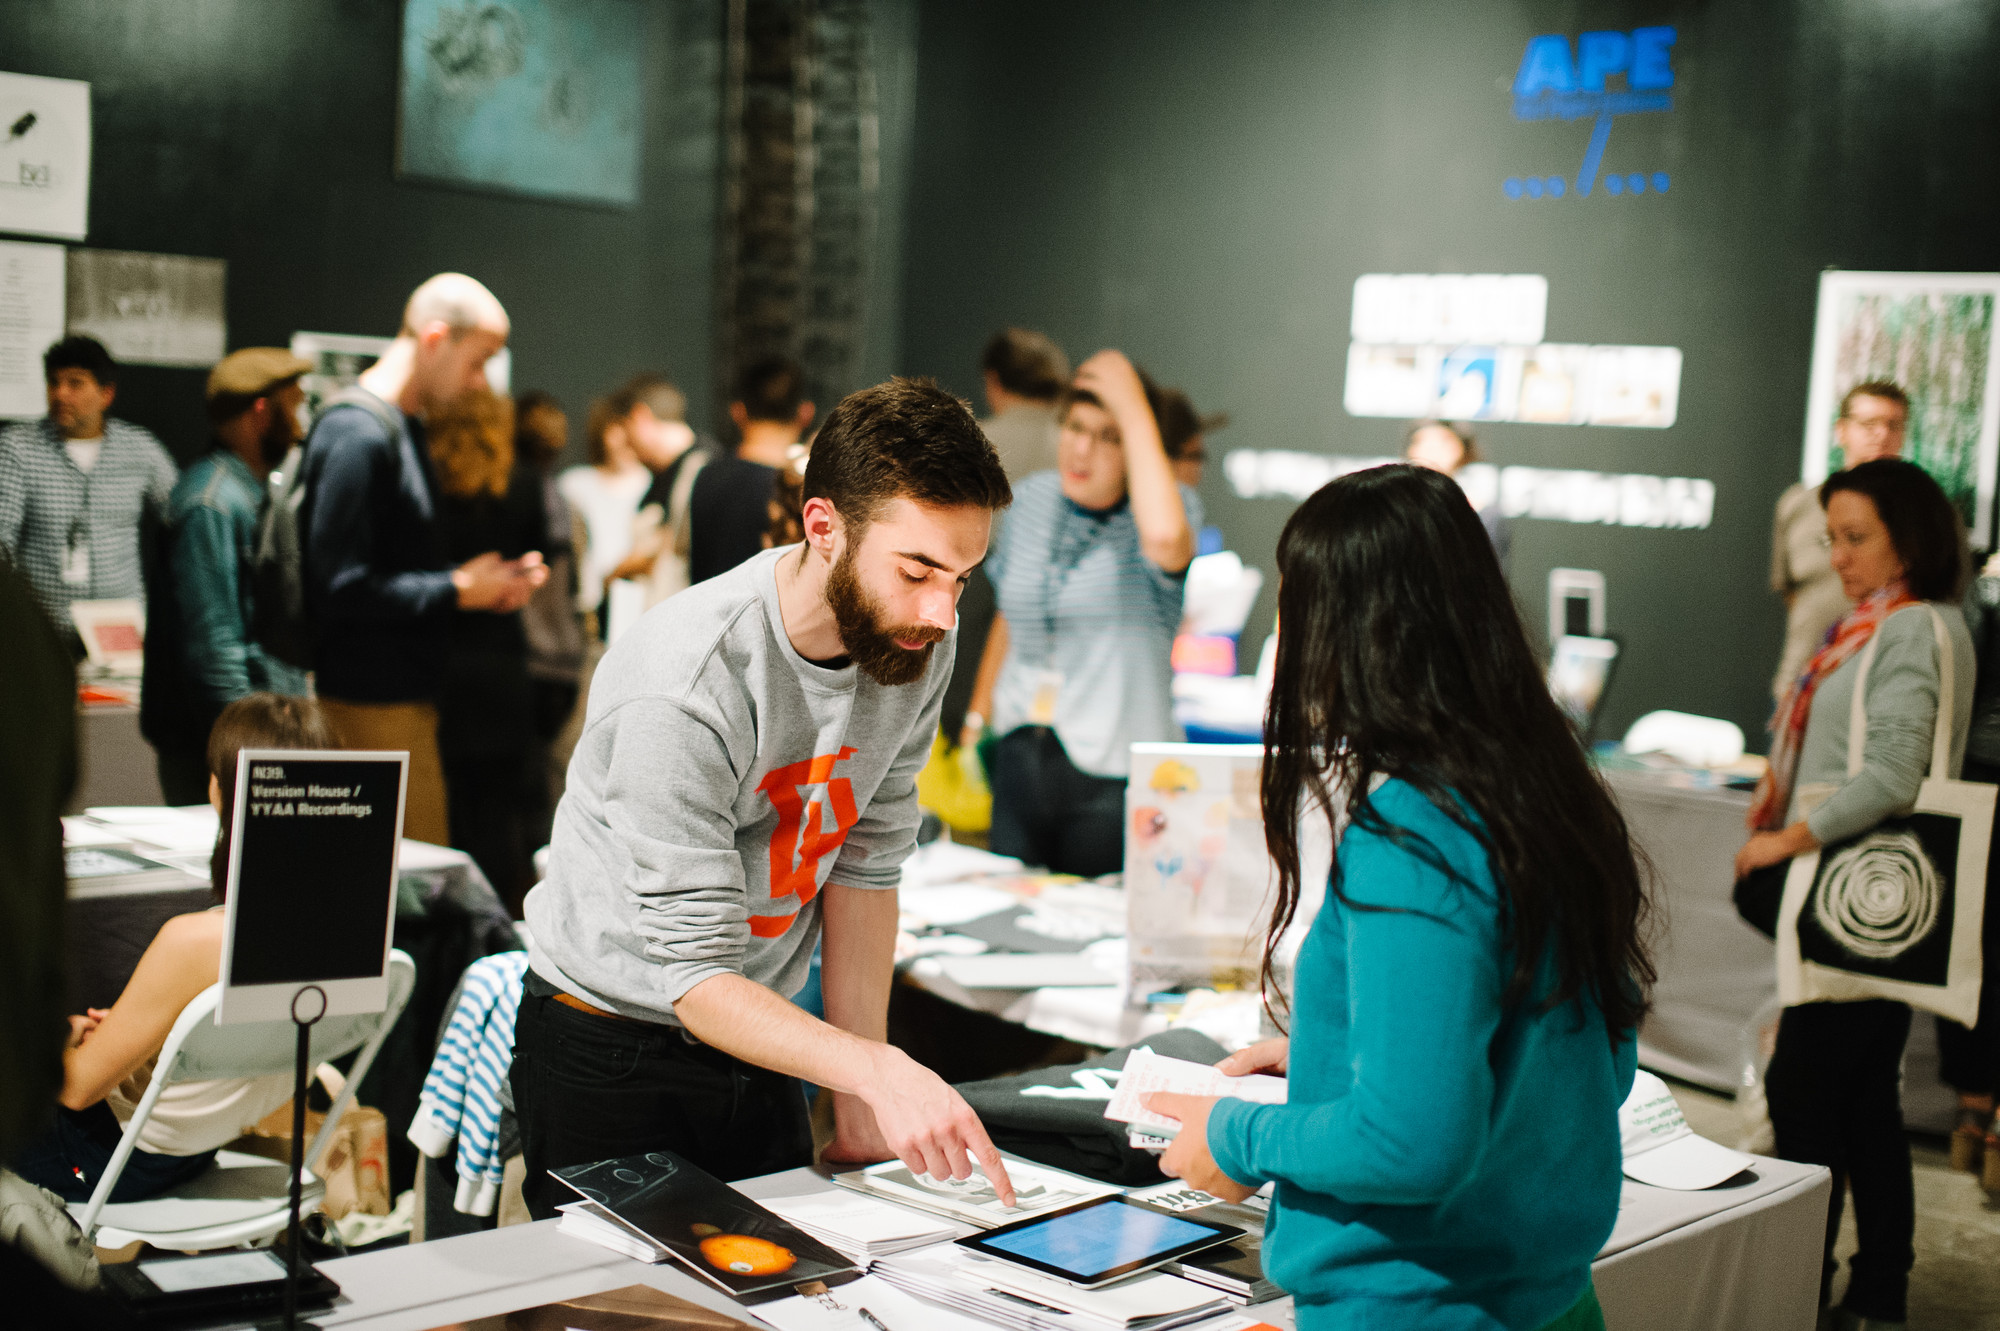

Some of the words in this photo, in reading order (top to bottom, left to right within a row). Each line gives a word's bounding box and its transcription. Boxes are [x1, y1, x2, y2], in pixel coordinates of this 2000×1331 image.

[1511, 25, 1678, 97] APE
[251, 784, 305, 798] Version
[308, 784, 352, 798] House
[251, 802, 295, 816] YYAA
[297, 802, 373, 818] Recordings
